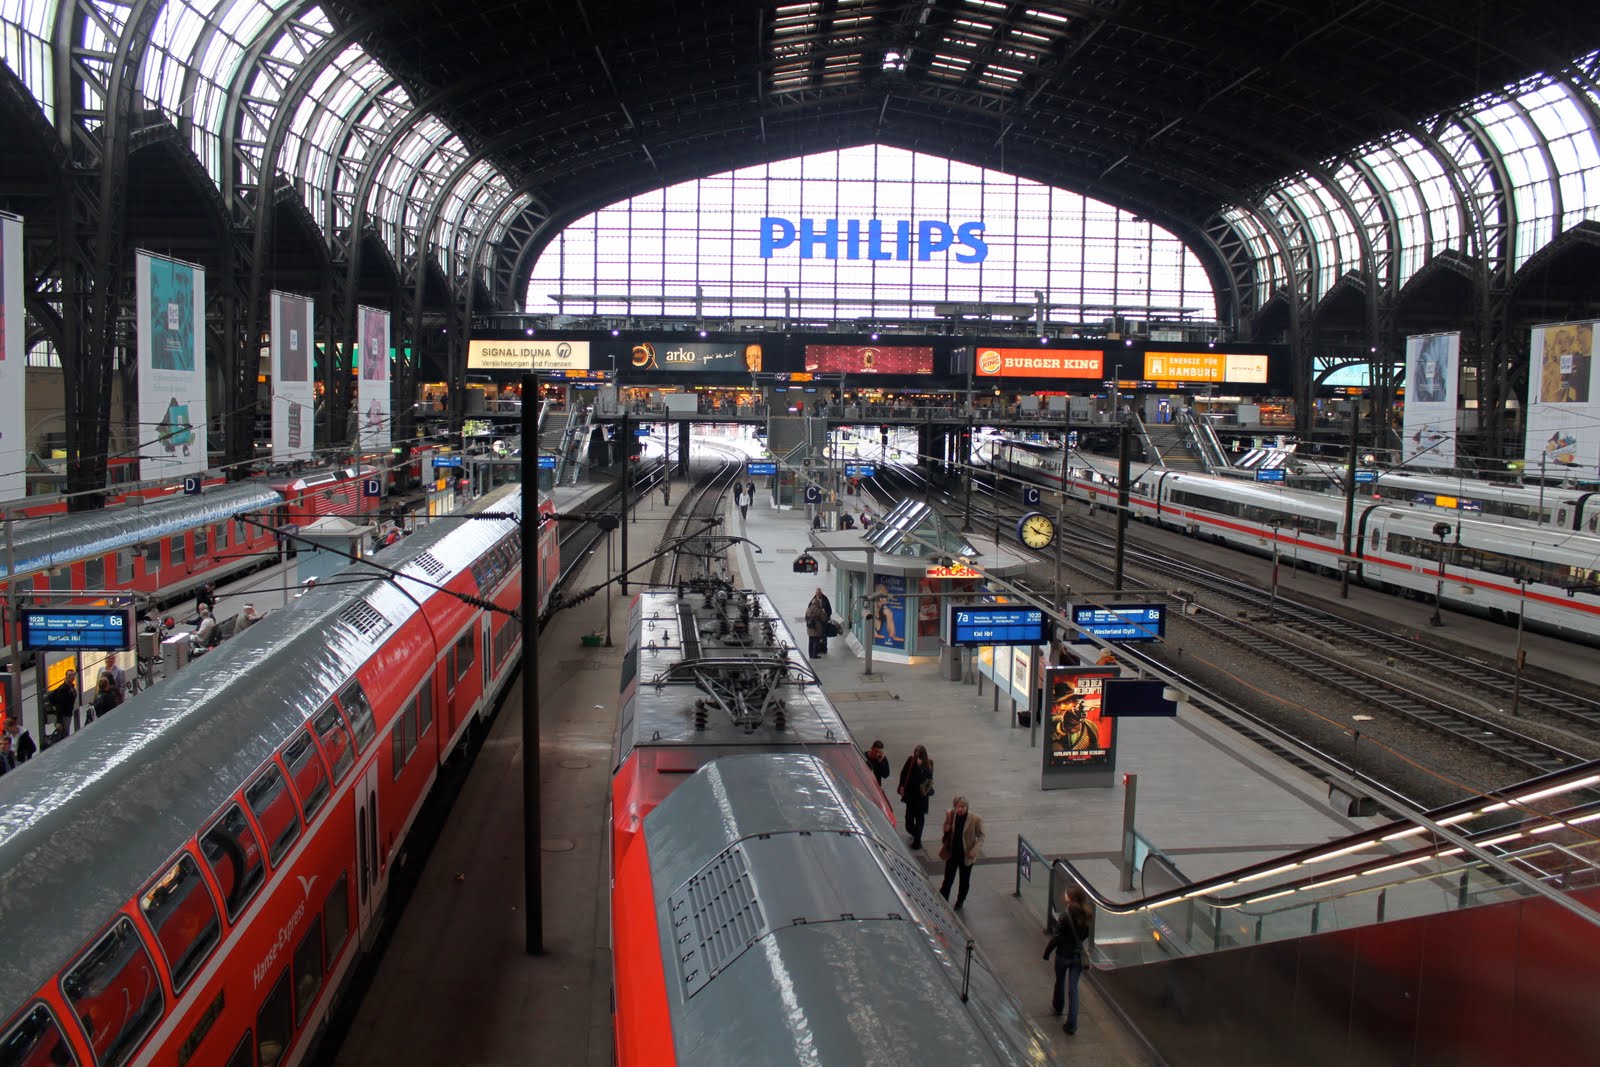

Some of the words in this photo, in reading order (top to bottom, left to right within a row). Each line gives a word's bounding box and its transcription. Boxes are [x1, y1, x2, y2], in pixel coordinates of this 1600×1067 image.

[760, 217, 988, 264] PHILIPS
[482, 348, 518, 357] SIGNAL
[521, 348, 551, 357] IDUNA
[666, 348, 695, 361] arko
[482, 360, 530, 368] Versicherungen
[982, 358, 1000, 368] KING
[1004, 357, 1061, 368] BURGER
[1063, 359, 1099, 369] KING
[1204, 357, 1218, 365] FÜR
[1169, 367, 1218, 377] HAMBURG
[185, 478, 195, 491] D
[369, 480, 379, 493] D
[806, 487, 817, 500] C
[1028, 489, 1038, 502] C
[936, 568, 975, 577] KIOSK
[880, 576, 901, 587] Coffee
[957, 612, 969, 623] 7a
[1148, 609, 1160, 619] 8a
[110, 616, 123, 626] 6a
[253, 900, 305, 991] Hanse-Express
